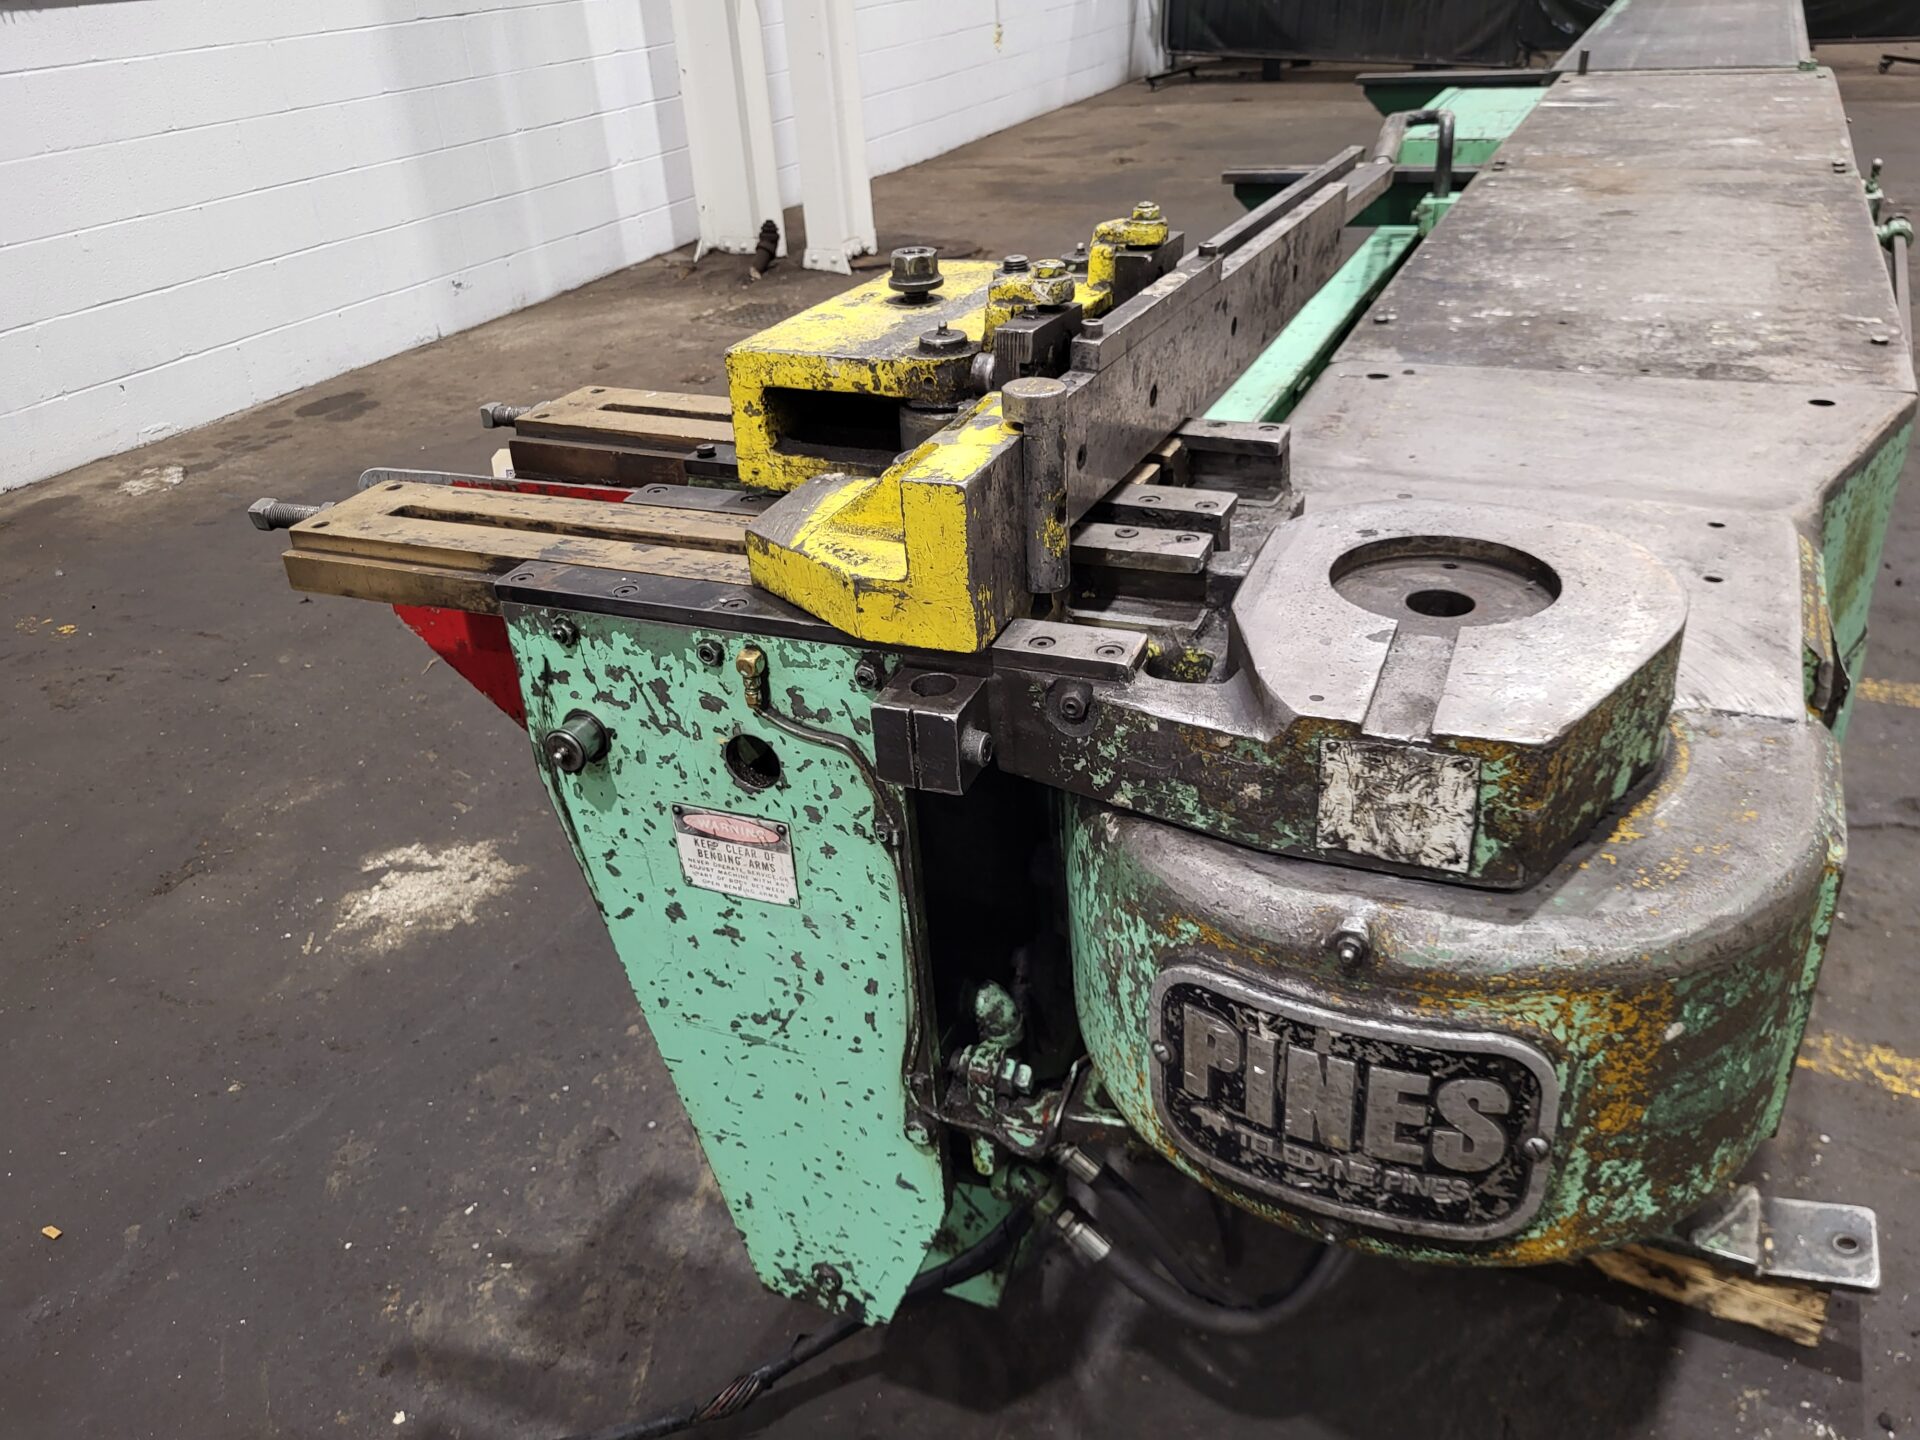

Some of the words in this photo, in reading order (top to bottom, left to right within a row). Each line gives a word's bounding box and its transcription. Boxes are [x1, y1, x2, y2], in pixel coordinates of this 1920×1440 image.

[699, 819, 766, 838] WARNING
[694, 838, 719, 850] KEEP
[726, 844, 757, 859] CLEAR
[764, 851, 776, 862] OF
[697, 848, 741, 866] BENDING
[749, 860, 776, 873] ARMS
[1183, 1003, 1511, 1173] PINES
[1384, 1168, 1472, 1204] PINES
